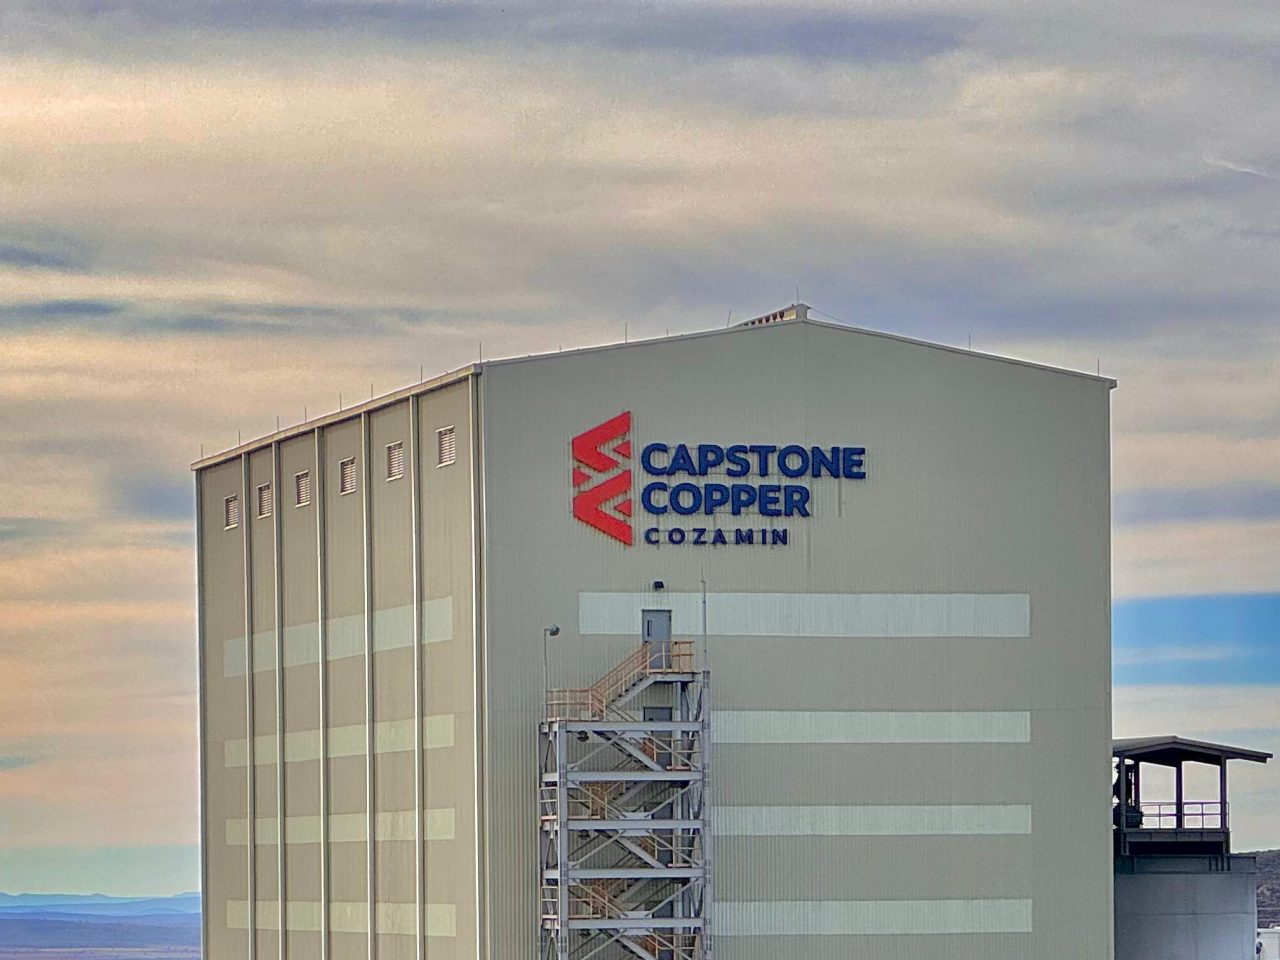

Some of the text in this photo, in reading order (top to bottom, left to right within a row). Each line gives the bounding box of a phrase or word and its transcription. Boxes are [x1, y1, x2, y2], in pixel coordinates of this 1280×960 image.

[641, 443, 866, 479] CAPSTONE
[641, 482, 810, 517] COPPER
[644, 527, 788, 545] COZAMIN
